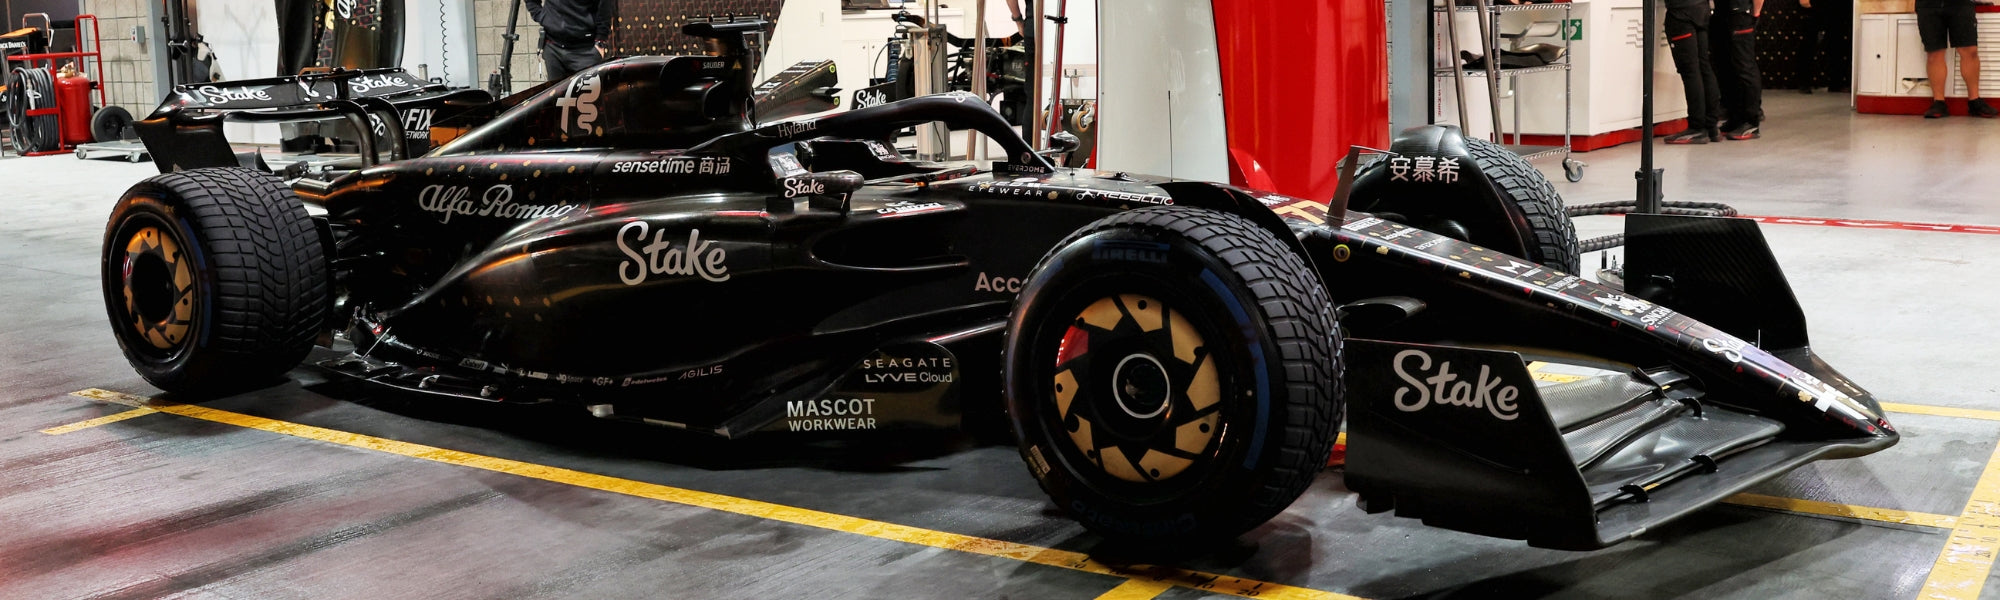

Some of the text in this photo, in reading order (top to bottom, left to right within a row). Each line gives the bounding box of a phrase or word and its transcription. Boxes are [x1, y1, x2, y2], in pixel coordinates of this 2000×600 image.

[349, 73, 409, 93] Stake
[199, 86, 272, 104] Stake
[856, 89, 887, 110] Stake
[406, 130, 429, 139] ETWORK
[778, 119, 816, 138] Hyland
[612, 157, 731, 175] sensetime 商汤
[1390, 155, 1460, 184] 安慕希
[784, 178, 825, 198] Stake
[968, 186, 1043, 196] EYEWEAR
[418, 183, 580, 224] Alfa Romeo
[1096, 190, 1174, 206] REBELLIO
[616, 221, 730, 286] Stake
[975, 272, 1026, 293] Acc
[678, 365, 723, 380] AGILIS
[863, 357, 952, 369] SEAGATE
[865, 371, 952, 383] LYVE Cloud
[1393, 349, 1519, 421] Stake
[787, 398, 875, 417] MASCOT
[788, 417, 876, 432] WORKWEAR
